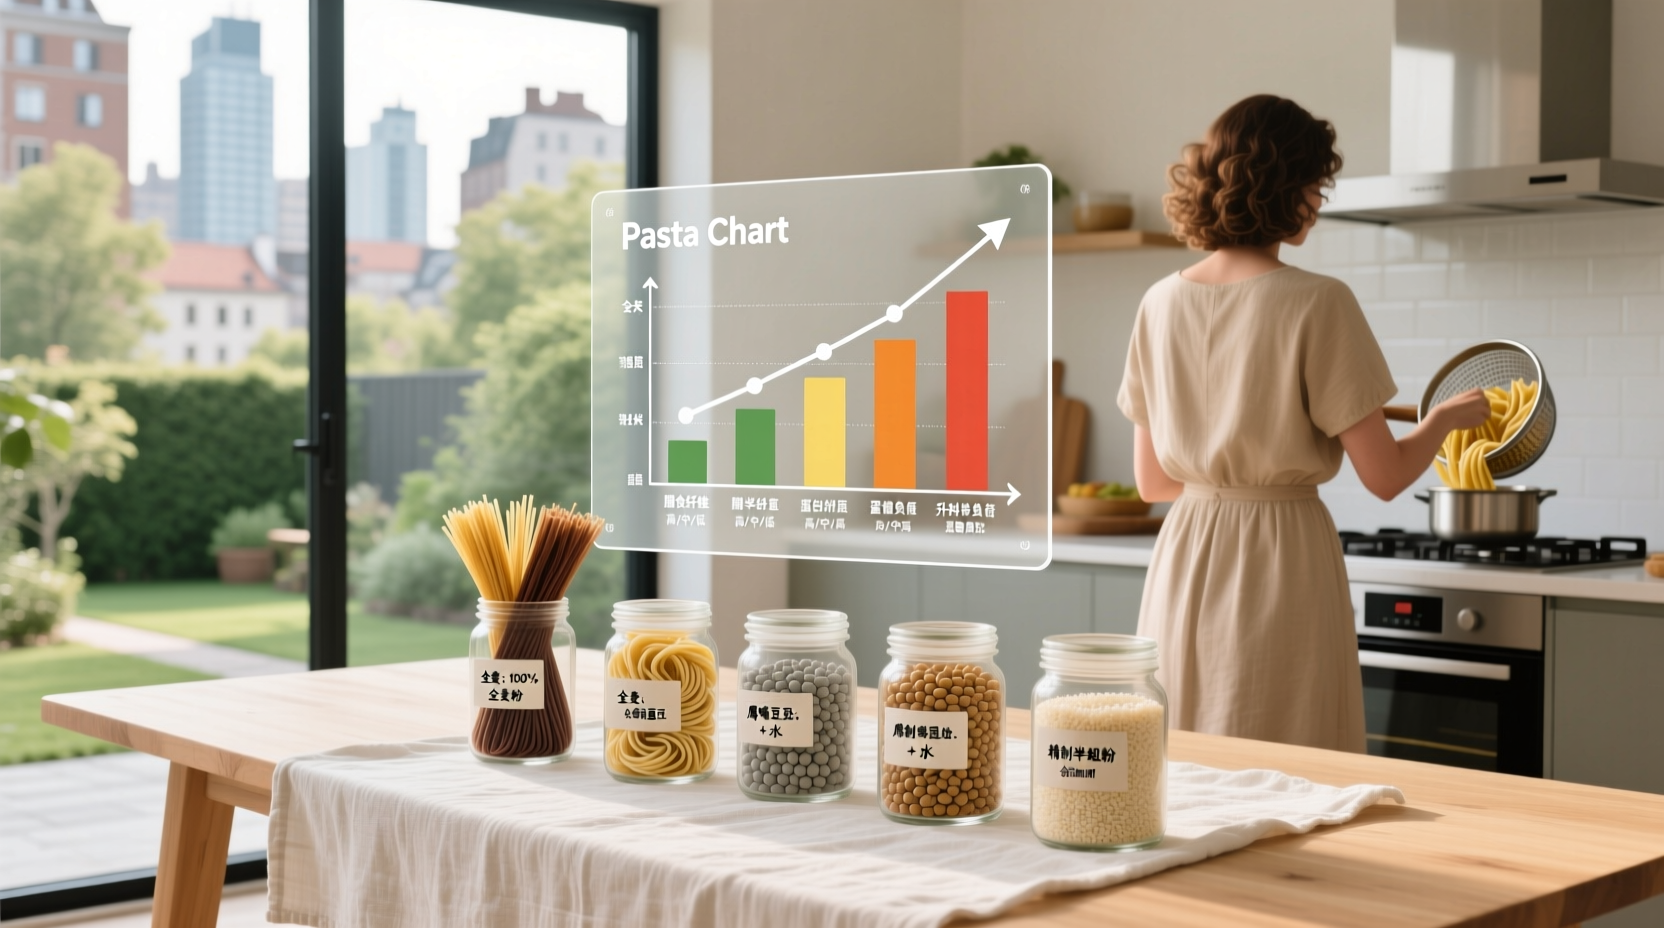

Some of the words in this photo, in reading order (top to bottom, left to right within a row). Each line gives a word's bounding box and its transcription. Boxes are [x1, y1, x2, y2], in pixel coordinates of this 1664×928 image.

[622, 220, 699, 250] Pasta
[708, 216, 789, 247] Chart
[769, 724, 783, 738] 水
[920, 744, 934, 760] 水
